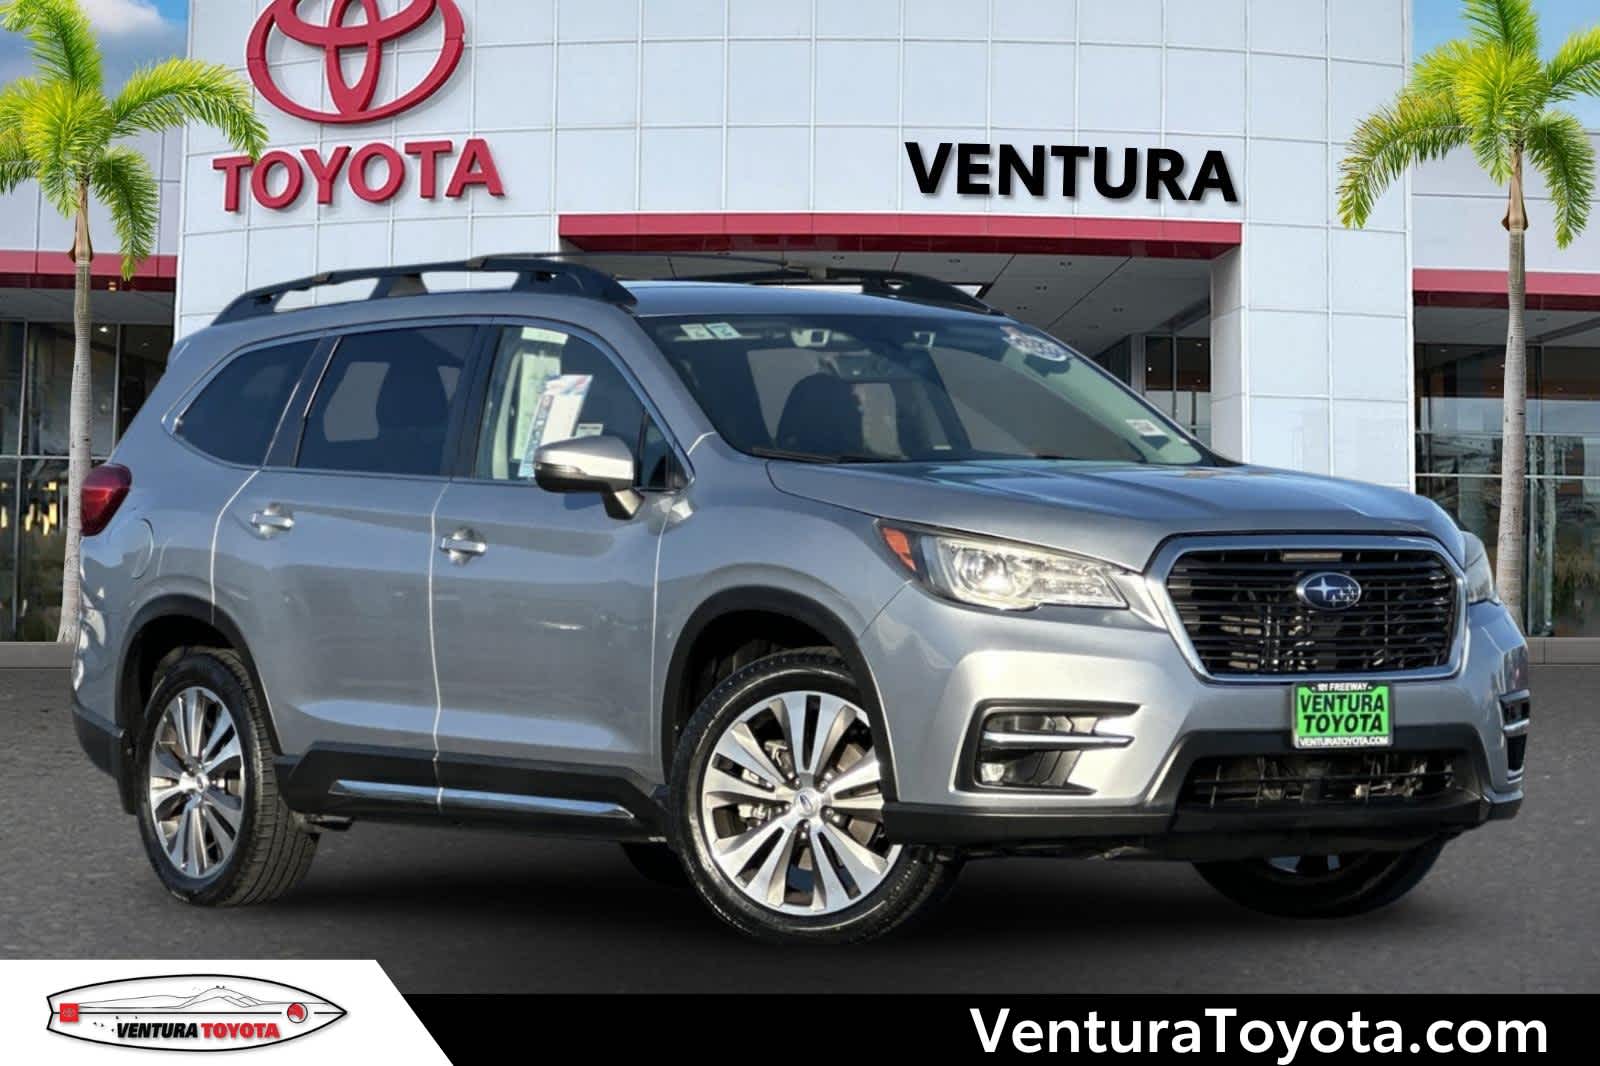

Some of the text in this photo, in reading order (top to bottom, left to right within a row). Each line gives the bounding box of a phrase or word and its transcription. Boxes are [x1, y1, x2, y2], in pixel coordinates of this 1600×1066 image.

[212, 138, 505, 213] TOYOTA
[904, 141, 1239, 203] VENTURA
[1329, 682, 1368, 691] FREEWAY
[1300, 694, 1384, 712] VENTURA
[1303, 713, 1383, 733] TOYOTA
[1299, 736, 1388, 745] VENTURATOYOTA.COM
